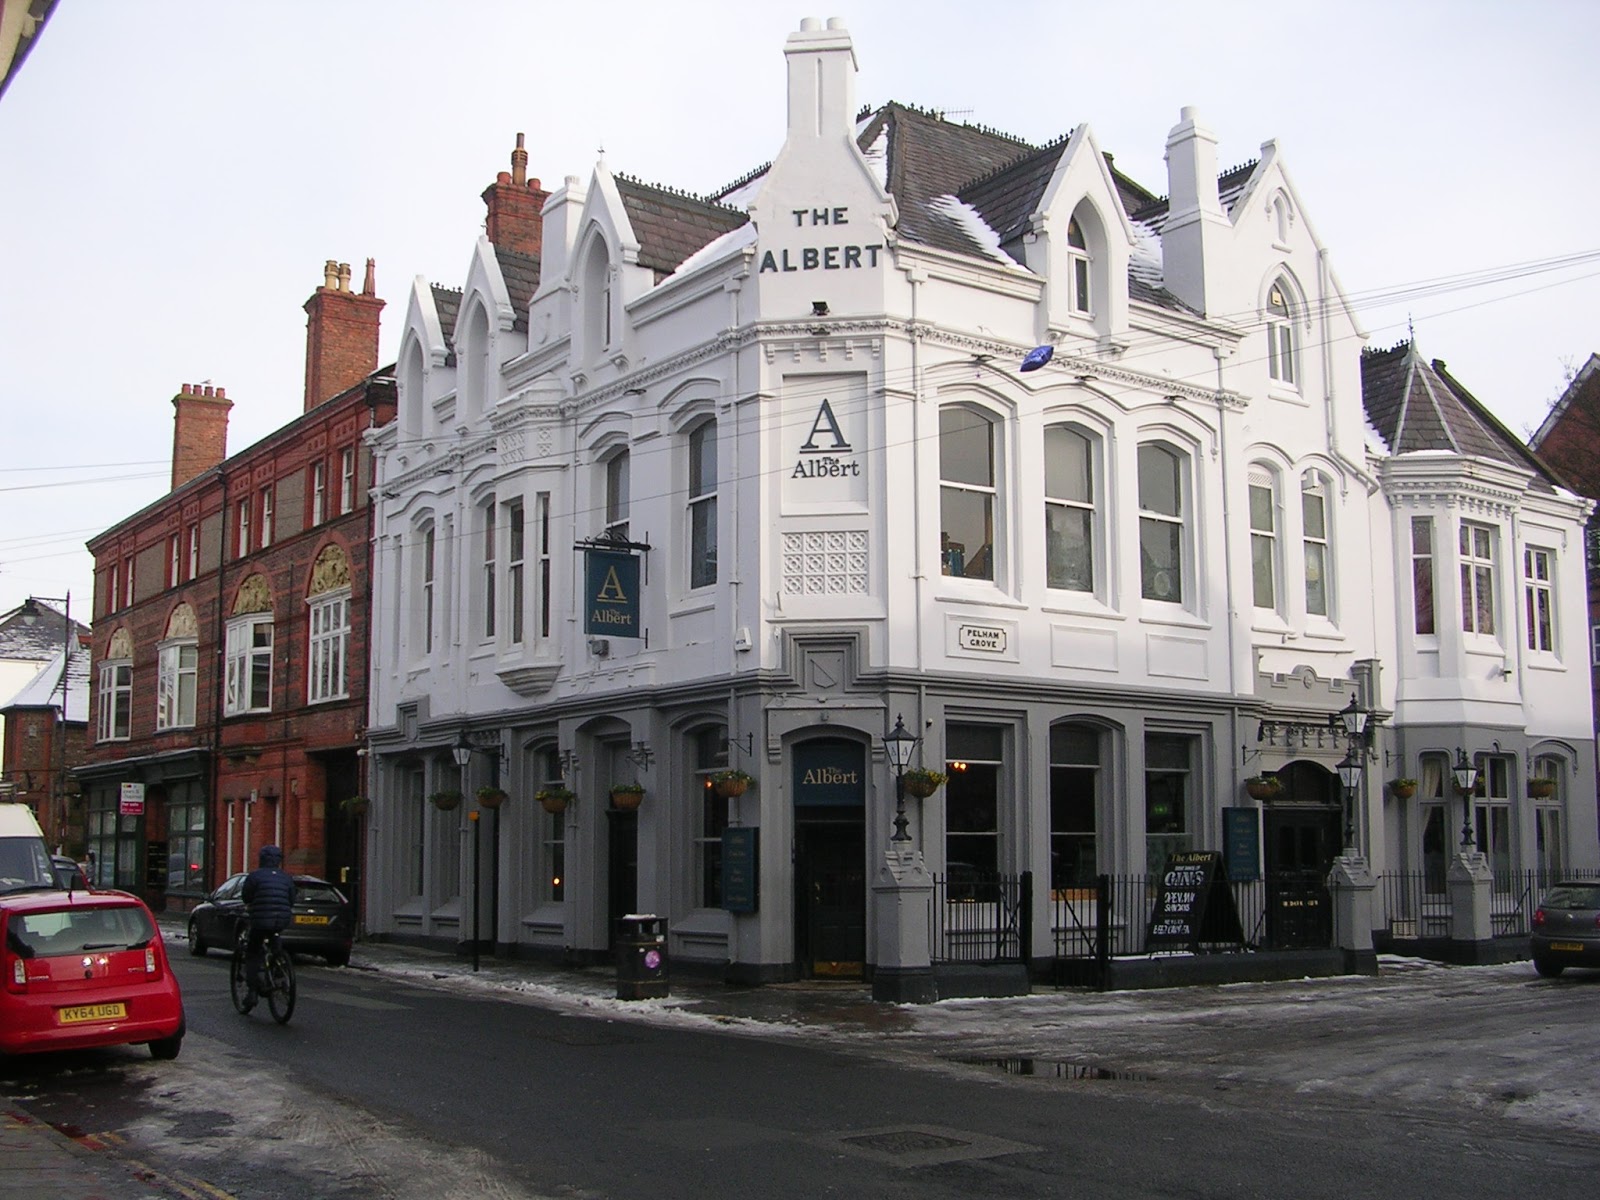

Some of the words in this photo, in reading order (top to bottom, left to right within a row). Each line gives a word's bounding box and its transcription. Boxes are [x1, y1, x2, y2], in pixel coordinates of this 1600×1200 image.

[792, 207, 849, 227] THE
[759, 244, 883, 274] ALBERT
[800, 398, 852, 449] A
[822, 456, 840, 465] The
[791, 460, 860, 479] Albert
[597, 565, 627, 599] A
[591, 609, 632, 625] Albert
[967, 629, 1000, 639] PELHAM
[970, 639, 997, 648] GROVE
[802, 768, 858, 785] Albert
[1171, 853, 1186, 862] The
[1186, 853, 1212, 862] Albert
[64, 1007, 95, 1020] KY64
[98, 1005, 120, 1017] UGD
